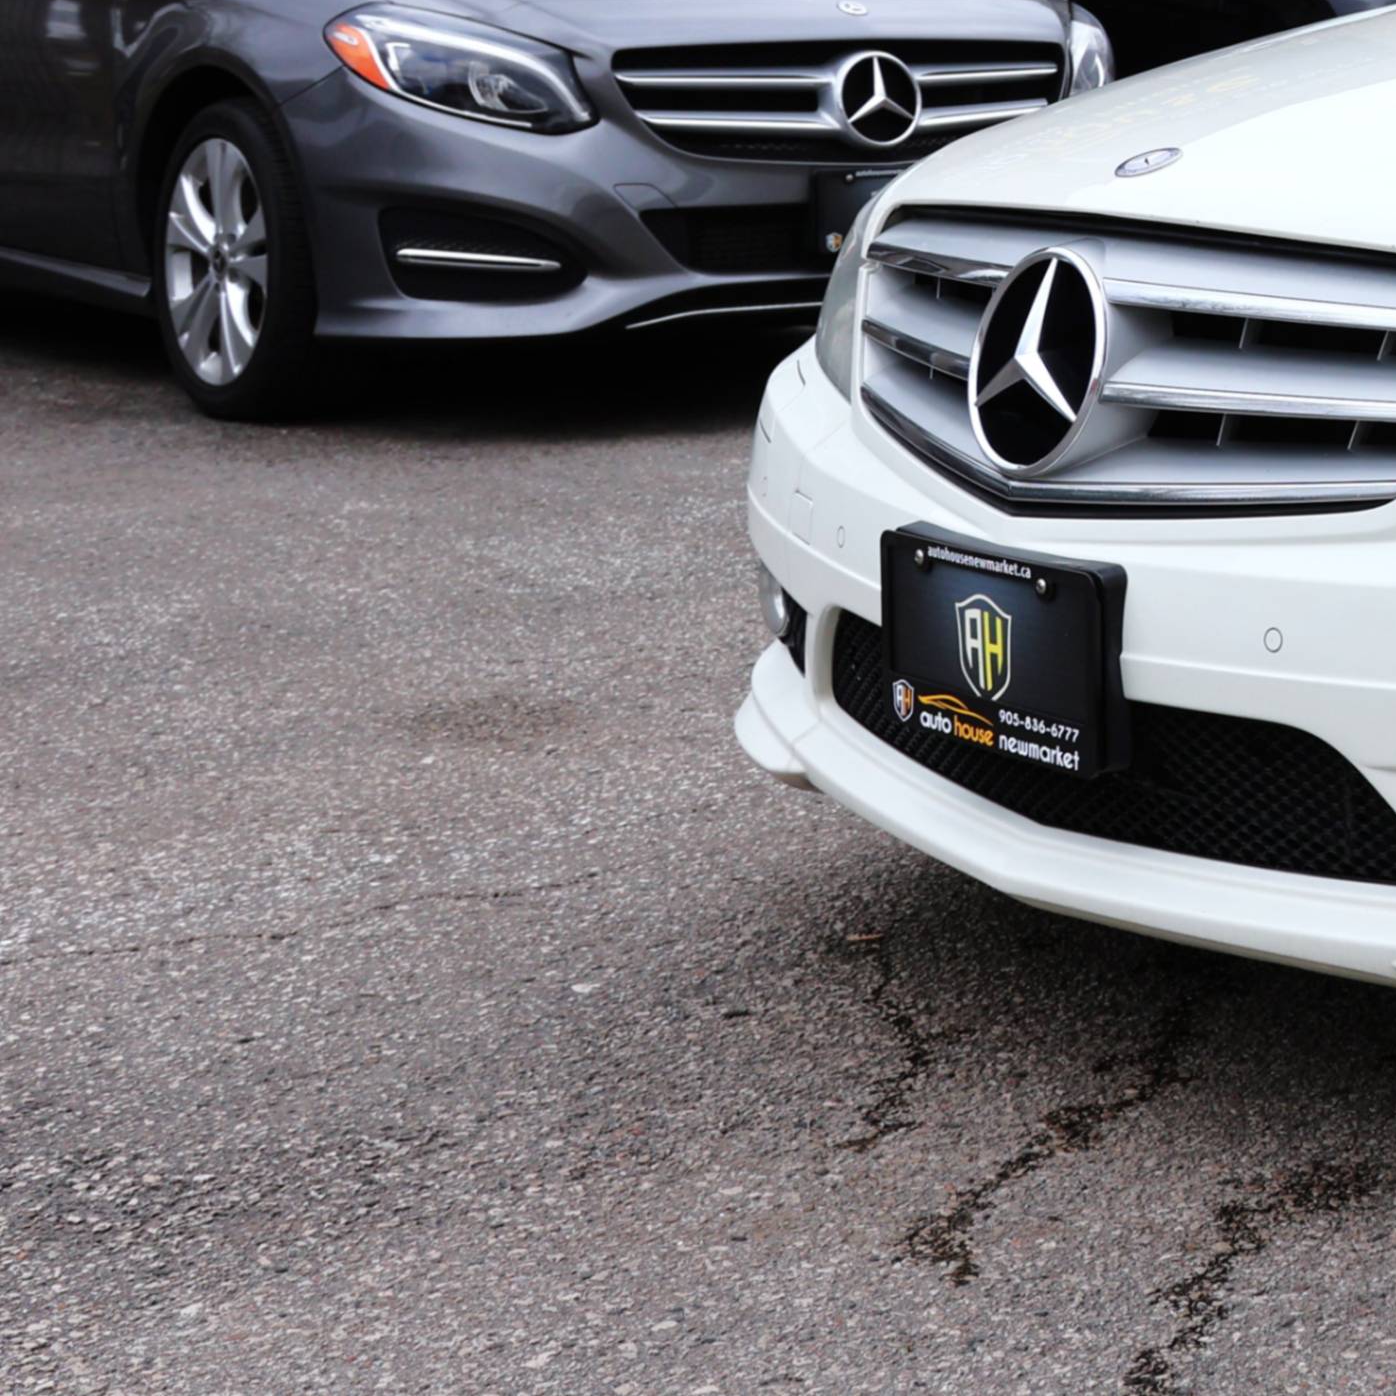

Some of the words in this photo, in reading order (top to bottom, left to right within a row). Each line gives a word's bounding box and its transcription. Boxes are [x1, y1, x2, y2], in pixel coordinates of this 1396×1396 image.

[927, 546, 1032, 579] autohousenewmarket.ca
[919, 710, 952, 734] auto
[953, 714, 994, 747] house
[998, 733, 1080, 772] newmarket
[998, 708, 1080, 743] 905-836-6777
